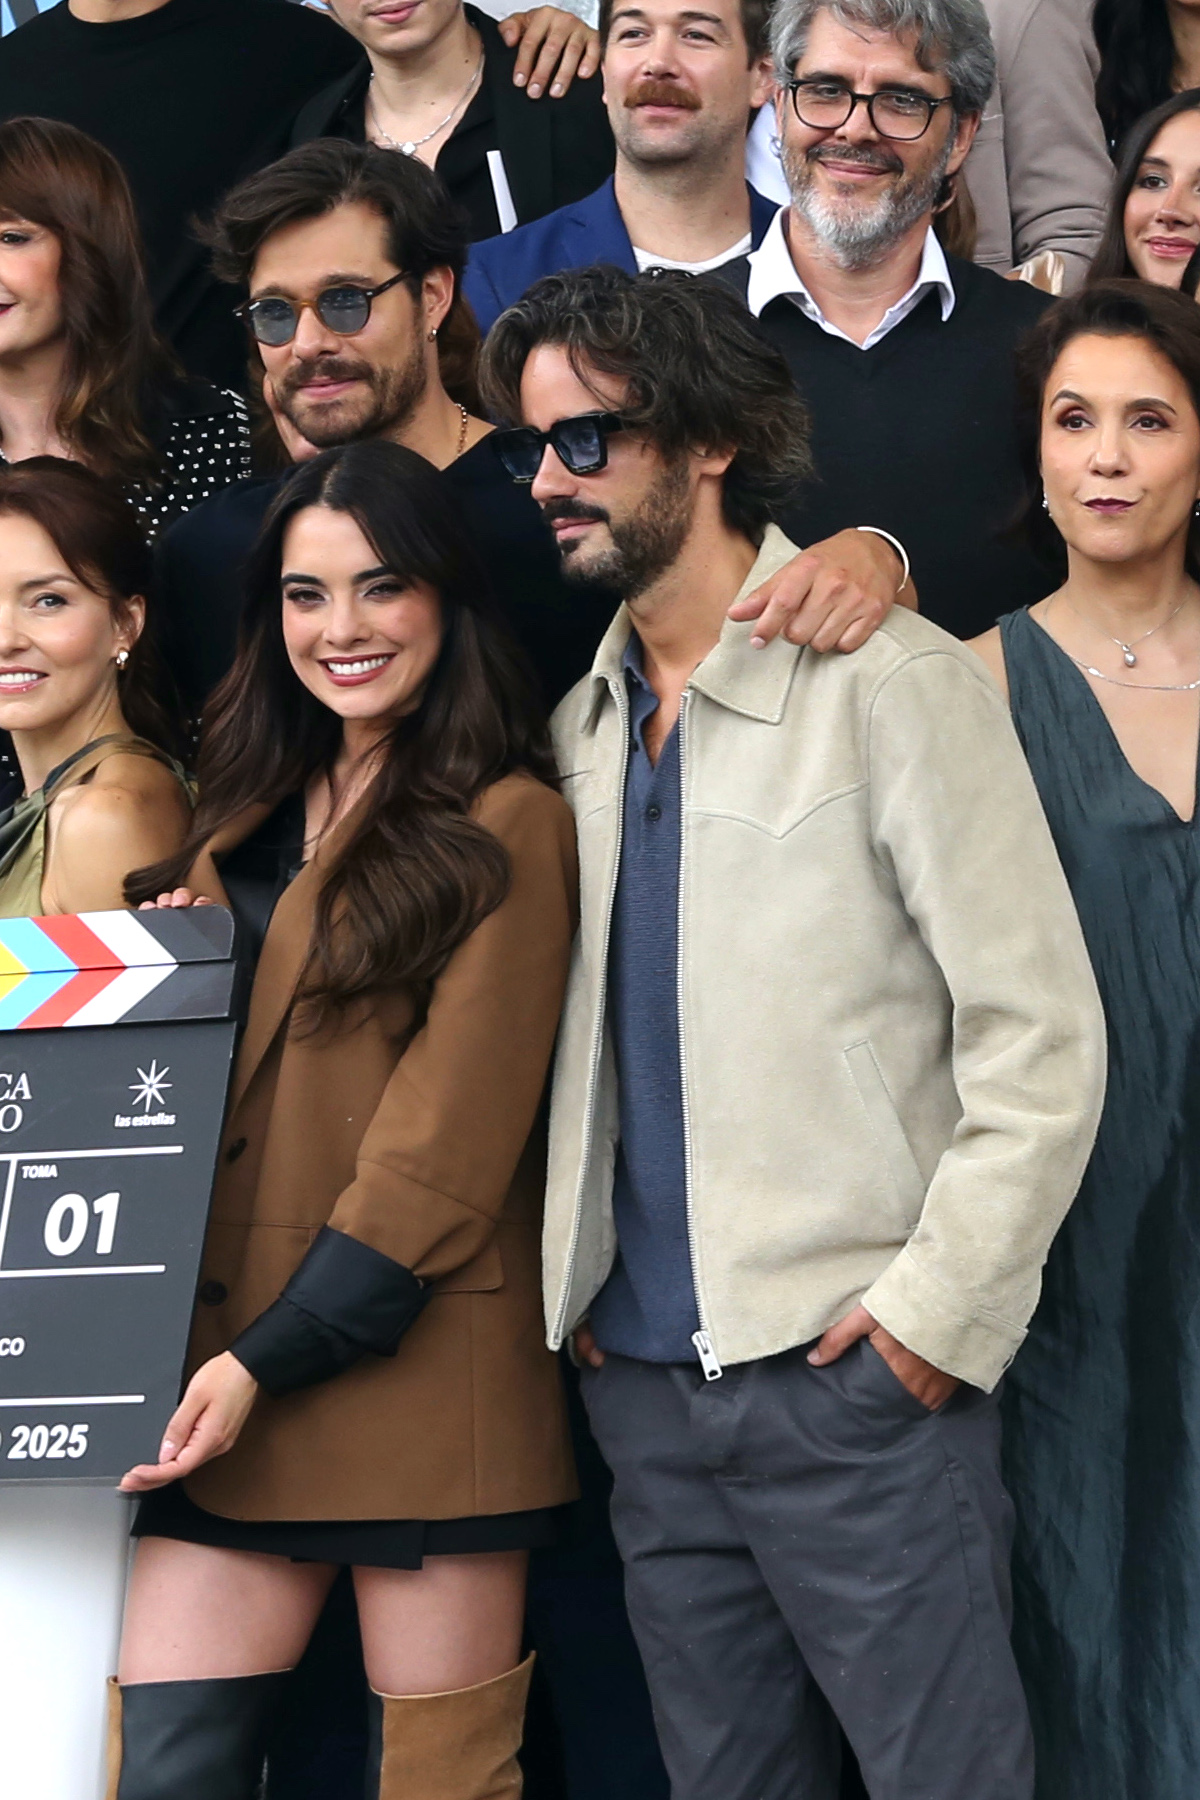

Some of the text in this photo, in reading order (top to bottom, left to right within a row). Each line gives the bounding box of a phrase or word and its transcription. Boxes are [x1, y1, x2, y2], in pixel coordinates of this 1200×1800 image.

[115, 1113, 176, 1127] las estrellas
[22, 1165, 58, 1179] TOMA
[44, 1192, 120, 1256] 01
[7, 1424, 88, 1459] 2025
